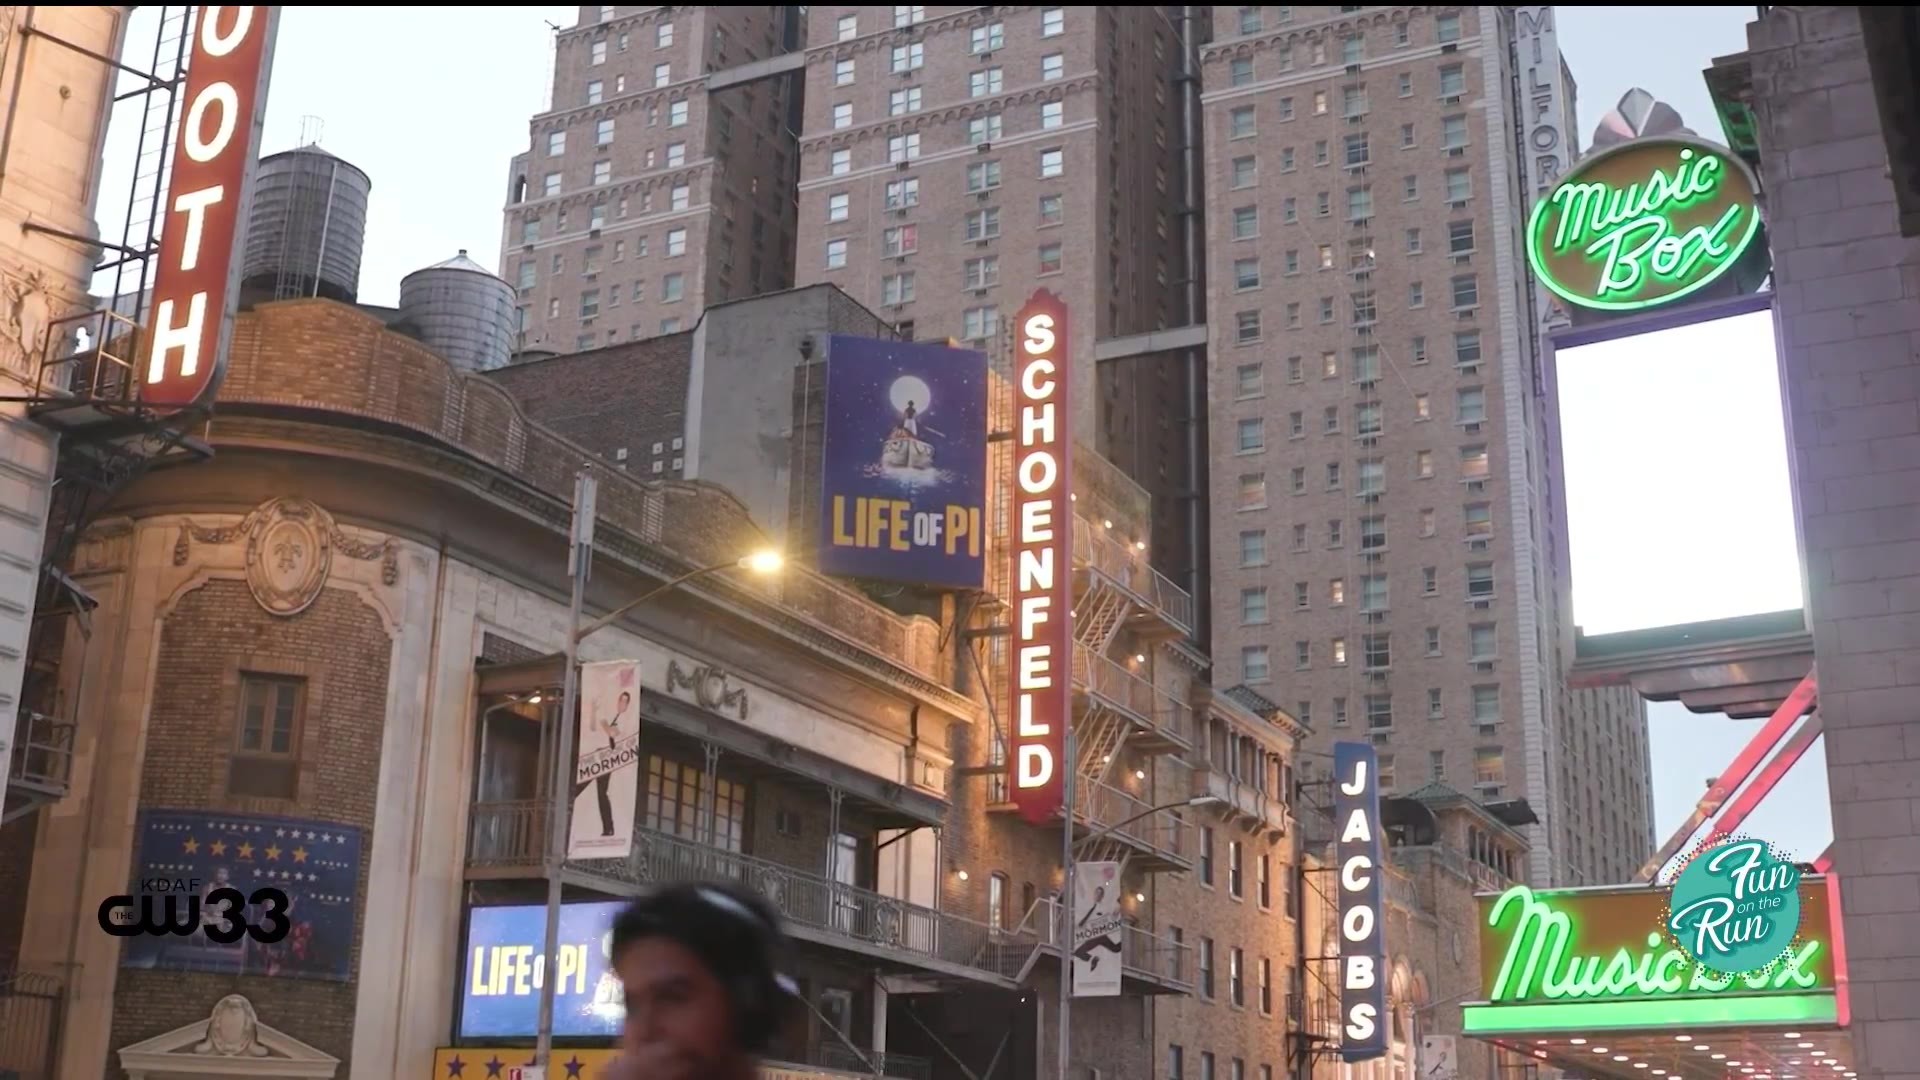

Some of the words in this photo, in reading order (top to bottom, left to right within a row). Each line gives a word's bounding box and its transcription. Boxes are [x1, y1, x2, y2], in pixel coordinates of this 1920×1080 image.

[1517, 8, 1560, 199] MILFOR
[1552, 148, 1720, 249] Music
[1586, 203, 1740, 295] Box
[833, 495, 912, 551] LIFE
[913, 513, 943, 547] OF
[945, 505, 980, 557] PI
[1018, 313, 1058, 789] SCHOENFELD
[579, 745, 640, 780] MORMON
[1076, 919, 1122, 940] MORMON
[1341, 761, 1377, 1041] JACOBS
[1488, 885, 1689, 1001] Music
[471, 945, 533, 996] LIFE
[556, 944, 588, 995] PI
